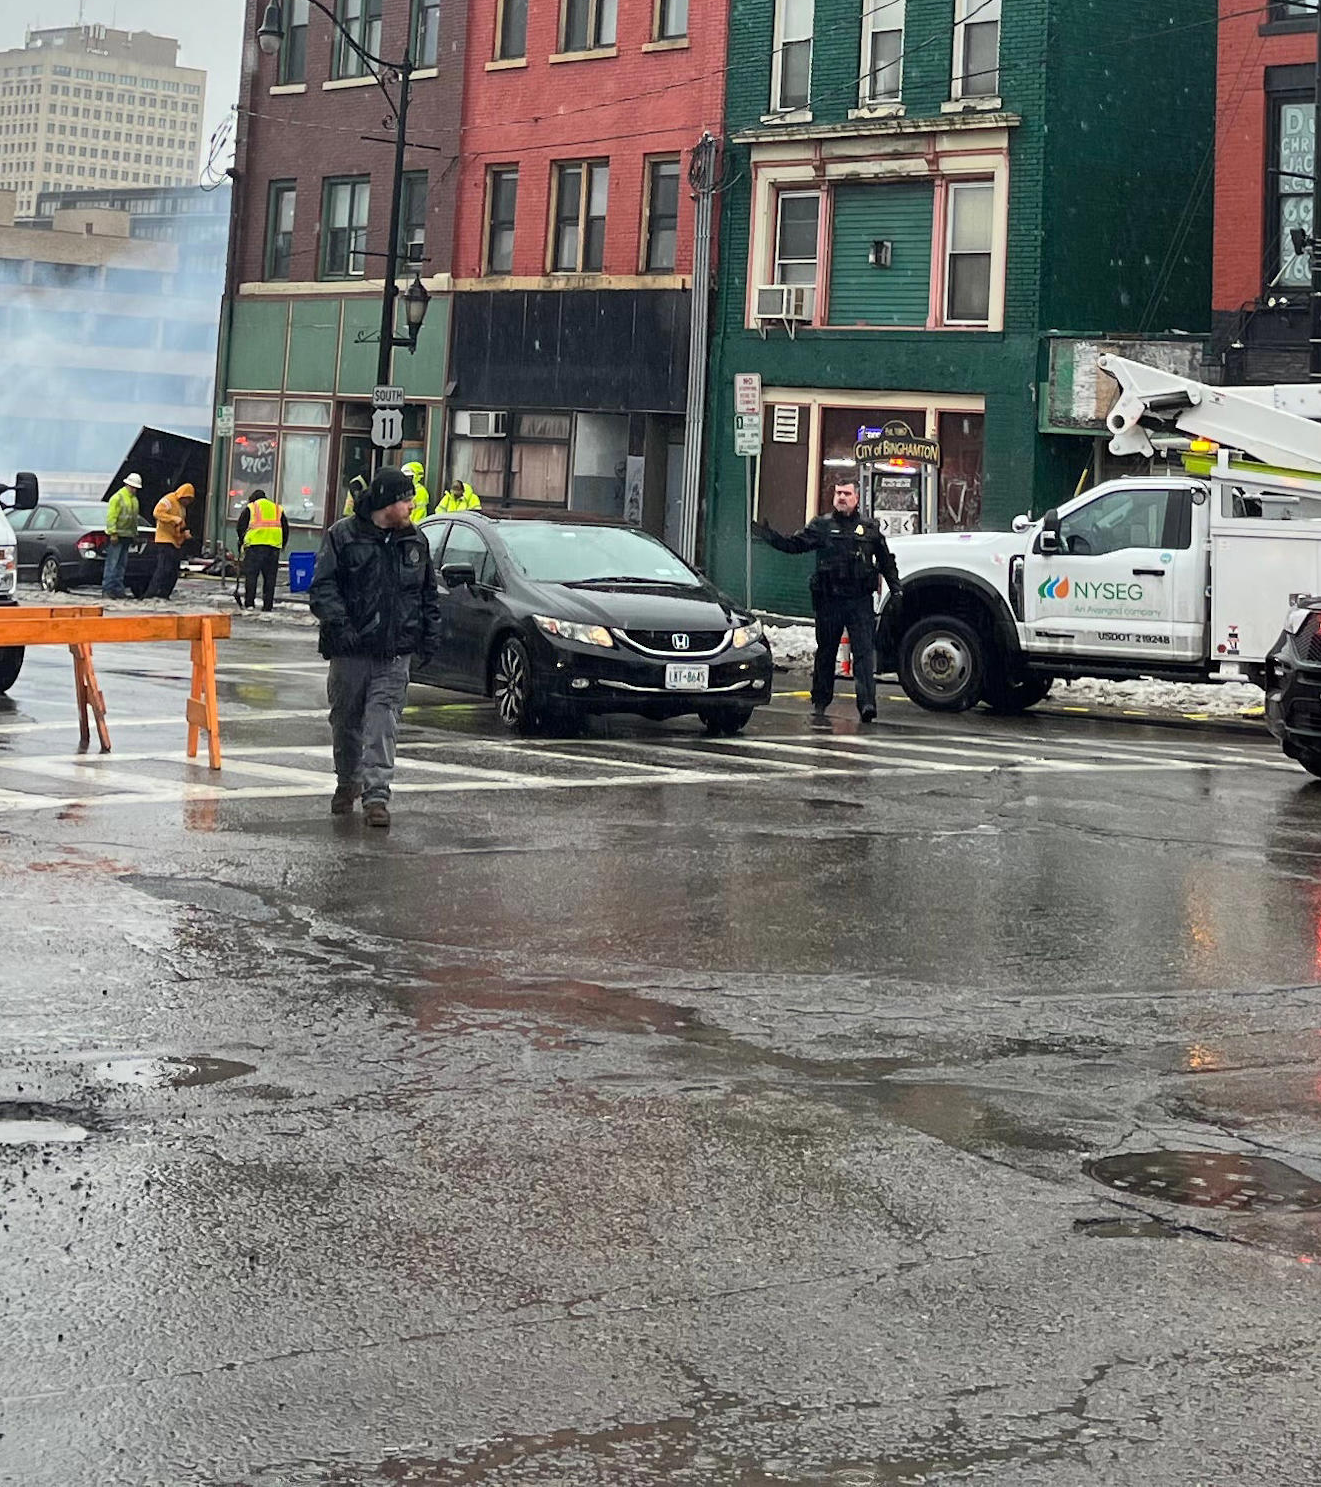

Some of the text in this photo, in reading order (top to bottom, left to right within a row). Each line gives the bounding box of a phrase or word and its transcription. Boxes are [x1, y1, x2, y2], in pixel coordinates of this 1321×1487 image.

[374, 389, 403, 402] SOUTH
[381, 417, 394, 440] 11
[873, 441, 883, 456] of
[883, 440, 938, 462] BINGHAMTON
[1073, 580, 1144, 602] NYSEG
[1098, 631, 1132, 642] USDOT
